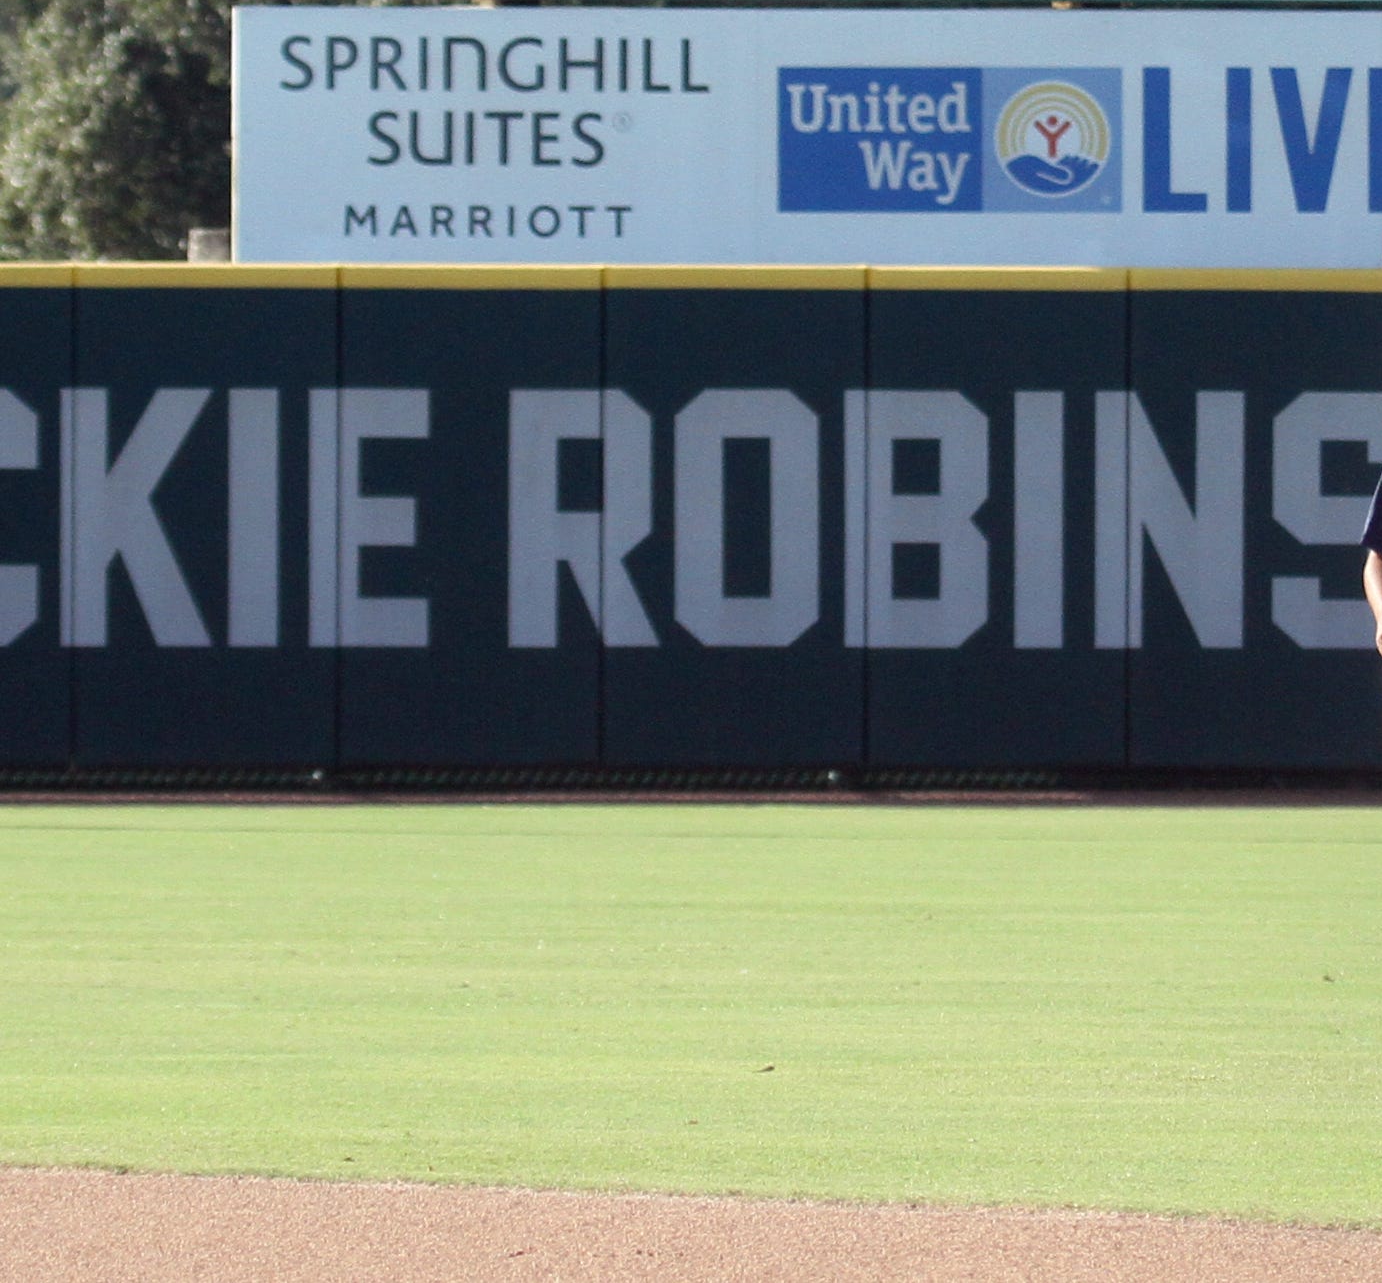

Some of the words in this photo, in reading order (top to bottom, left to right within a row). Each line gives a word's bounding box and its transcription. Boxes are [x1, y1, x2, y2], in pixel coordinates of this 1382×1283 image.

[279, 36, 710, 93] SPRINGHILL
[787, 83, 971, 133] United
[366, 111, 605, 166] SUITES
[859, 141, 970, 204] Way
[343, 205, 632, 238] MARRIOTT
